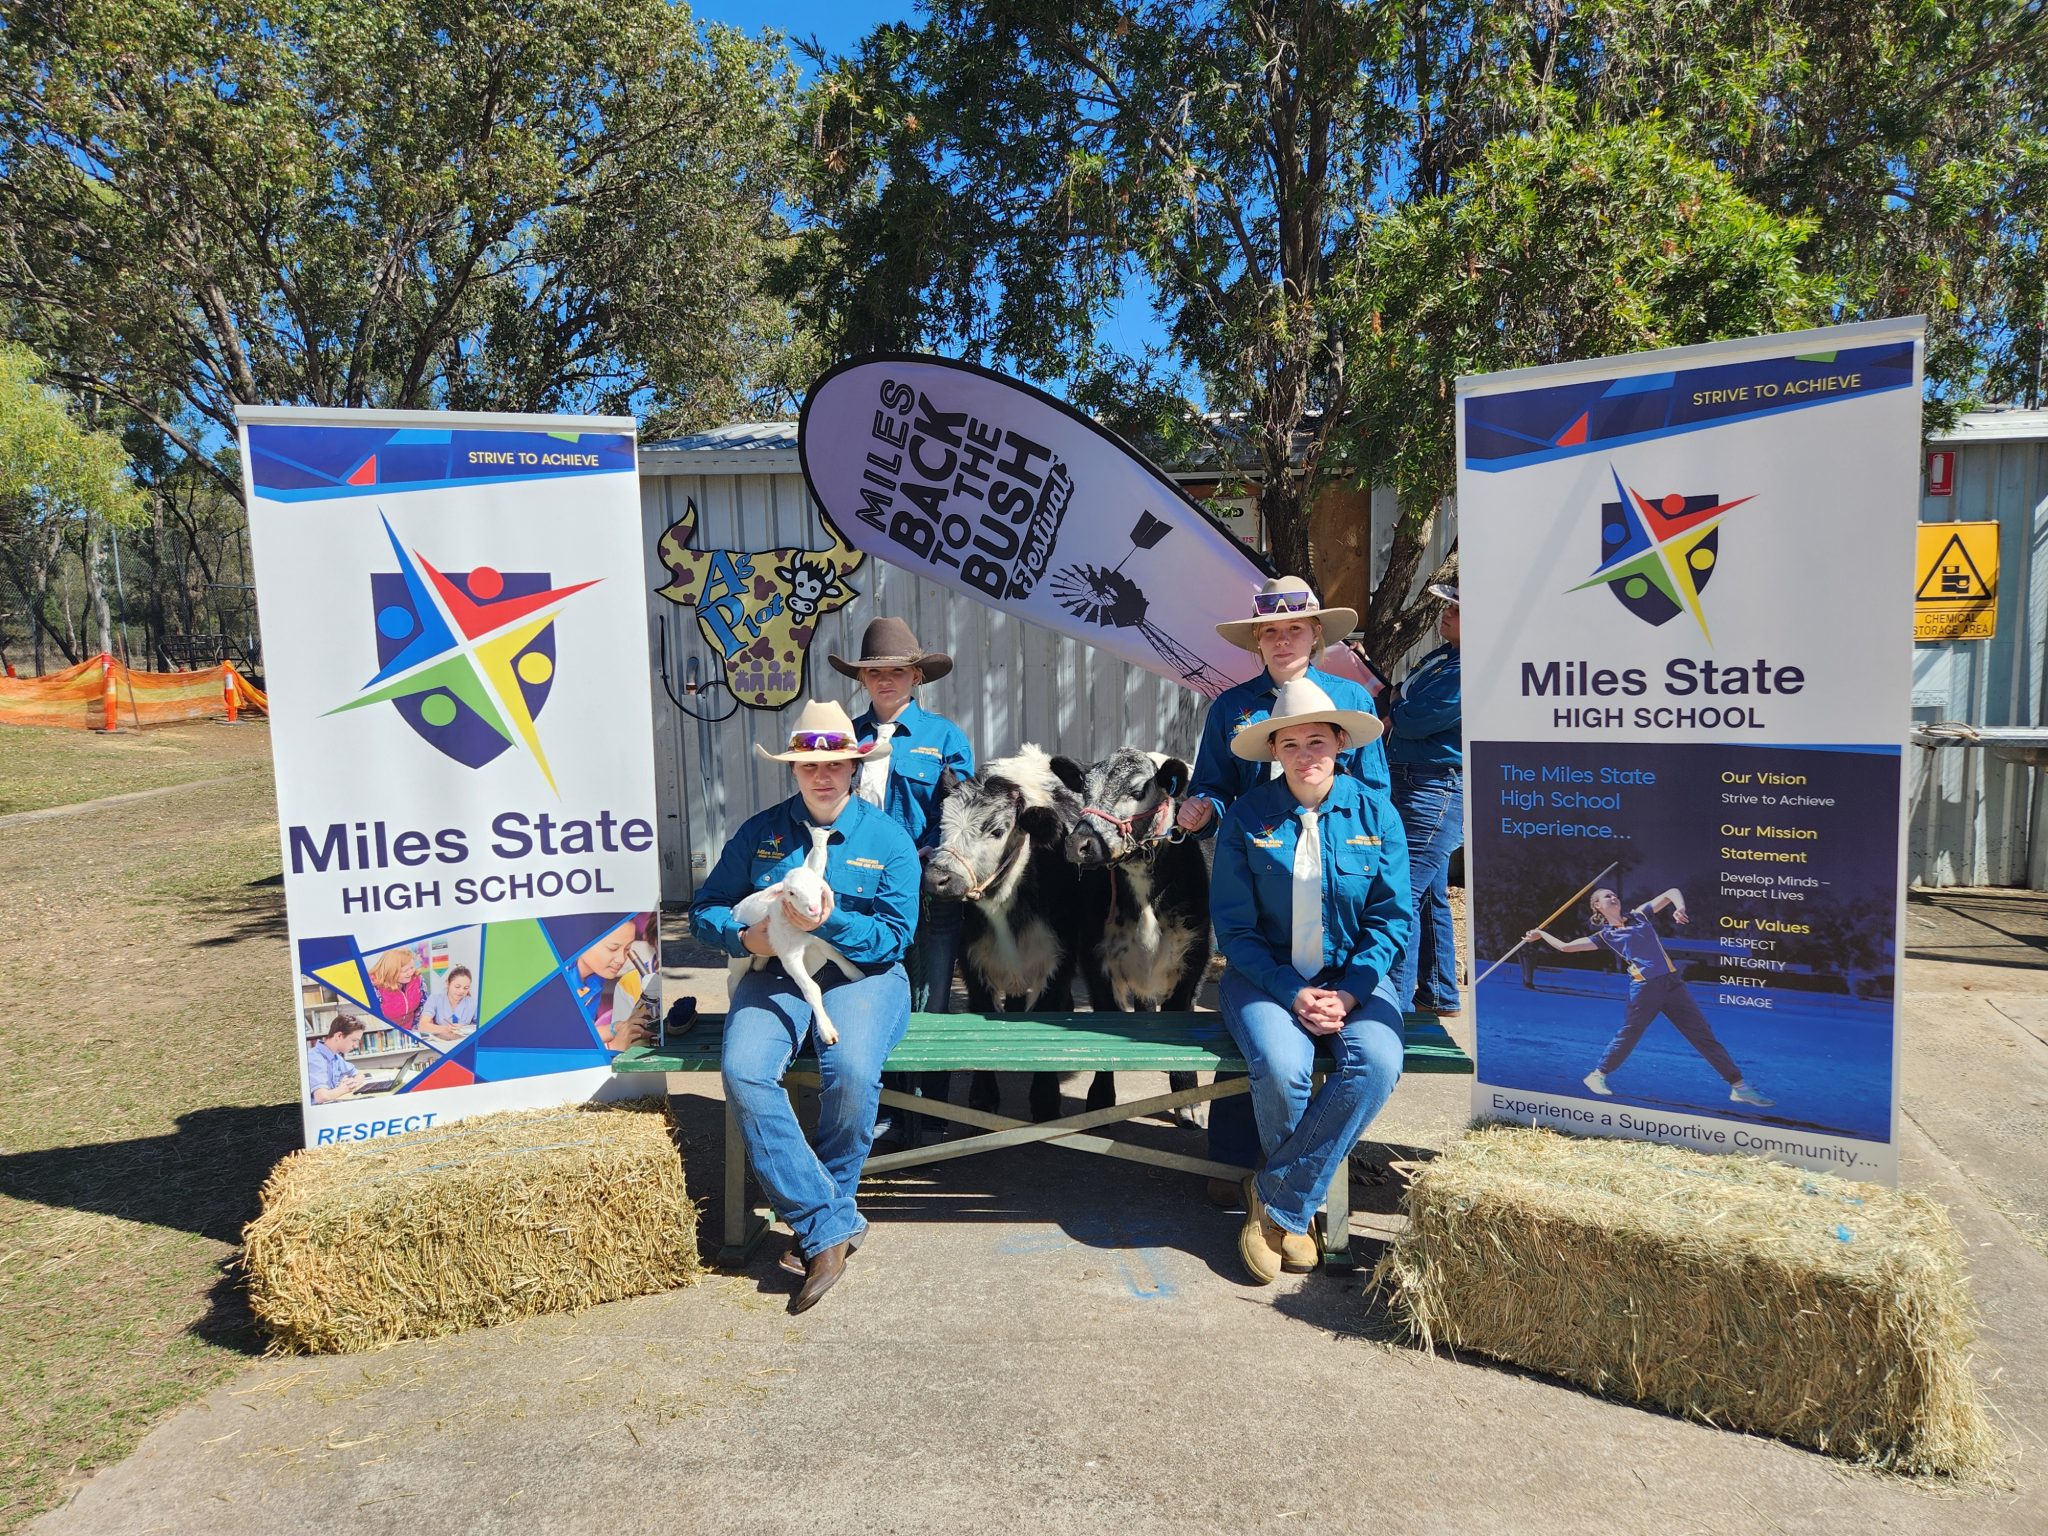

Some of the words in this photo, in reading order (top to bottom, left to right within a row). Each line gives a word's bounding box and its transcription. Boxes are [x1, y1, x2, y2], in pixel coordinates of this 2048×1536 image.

[1693, 387, 1749, 406] STRIVE
[1754, 384, 1778, 398] TO
[1783, 374, 1861, 396] ACHIEVE
[468, 451, 515, 464] STRIVE
[518, 452, 538, 465] TO
[541, 453, 599, 466] ACHIEVE
[855, 379, 915, 533] MILES
[952, 418, 1002, 501] THE
[888, 392, 968, 560] BACK
[960, 430, 1051, 600] BUSH
[1011, 465, 1073, 594] Festival
[929, 513, 971, 569] TO
[696, 549, 756, 608] Ag
[696, 593, 784, 661] Plot
[1913, 624, 1958, 635] STORAGE
[1963, 624, 1988, 634] AREA
[1924, 613, 1976, 624] CHEMICAL
[1521, 661, 1648, 696] Miles
[1664, 658, 1805, 696] State
[1553, 707, 1623, 728] HIGH
[1633, 707, 1765, 729] SCHOOL
[1500, 764, 1536, 782] The
[1542, 766, 1594, 783] Miles
[1600, 767, 1656, 785] State
[1721, 771, 1752, 784] Our
[1757, 772, 1807, 785] Vision
[1501, 789, 1545, 811] High
[1551, 791, 1620, 810] School
[1721, 793, 1758, 804] Strive
[1762, 795, 1776, 805] to
[1779, 795, 1835, 807] Achieve
[1501, 817, 1631, 839] Experience...
[1720, 824, 1751, 837] Our
[1756, 825, 1818, 840] Mission
[288, 821, 469, 874] Miles
[491, 810, 653, 859] State
[1720, 847, 1807, 863] Statement
[1720, 871, 1774, 887] Develop
[1777, 875, 1819, 887] Minds
[342, 880, 442, 914] HIGH
[454, 868, 615, 905] SCHOOL
[1720, 885, 1767, 899] Impact
[1771, 889, 1805, 901] Lives
[1720, 916, 1750, 929] Our
[1755, 919, 1810, 934] Values
[1720, 936, 1777, 951] RESPECT
[1720, 956, 1786, 971] INTEGRITY
[1719, 975, 1766, 988] SAFETY
[1719, 994, 1773, 1009] ENGAGE
[317, 1113, 438, 1145] RESPECT
[1492, 1093, 1594, 1123] Experience
[1601, 1114, 1612, 1126] a
[1619, 1113, 1726, 1143] Supportive
[1734, 1130, 1878, 1168] Community...
